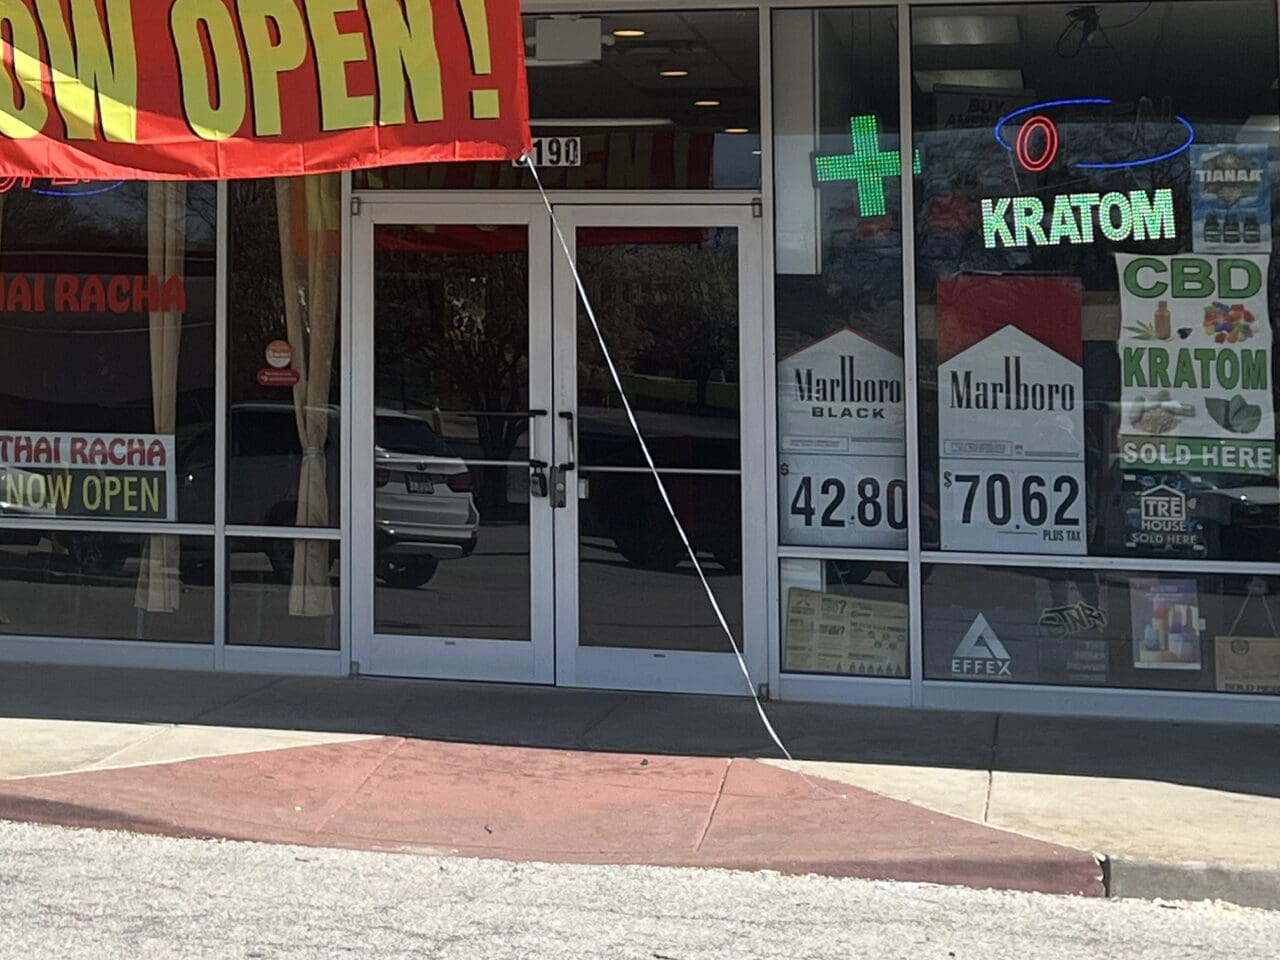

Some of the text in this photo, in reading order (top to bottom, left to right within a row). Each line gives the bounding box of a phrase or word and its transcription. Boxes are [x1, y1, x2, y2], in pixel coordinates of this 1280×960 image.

[981, 189, 1177, 248] KRATOM
[1122, 257, 1263, 300] CBD
[55, 273, 187, 313] RACHA
[794, 356, 902, 404] Marlboro
[1122, 346, 1268, 391] KRATOM
[950, 356, 1075, 411] Marlboro
[811, 407, 886, 419] BLACK
[71, 437, 167, 465] RACHA
[1123, 442, 1273, 469] SOLD HERE
[6, 473, 159, 513] NOW OPEN
[1146, 497, 1182, 517] TRE
[1043, 530, 1081, 542] PLUS TAX
[1132, 533, 1197, 545] SOLD HERE
[1141, 520, 1186, 532] HOUSE
[951, 659, 1012, 676] EFFEX
